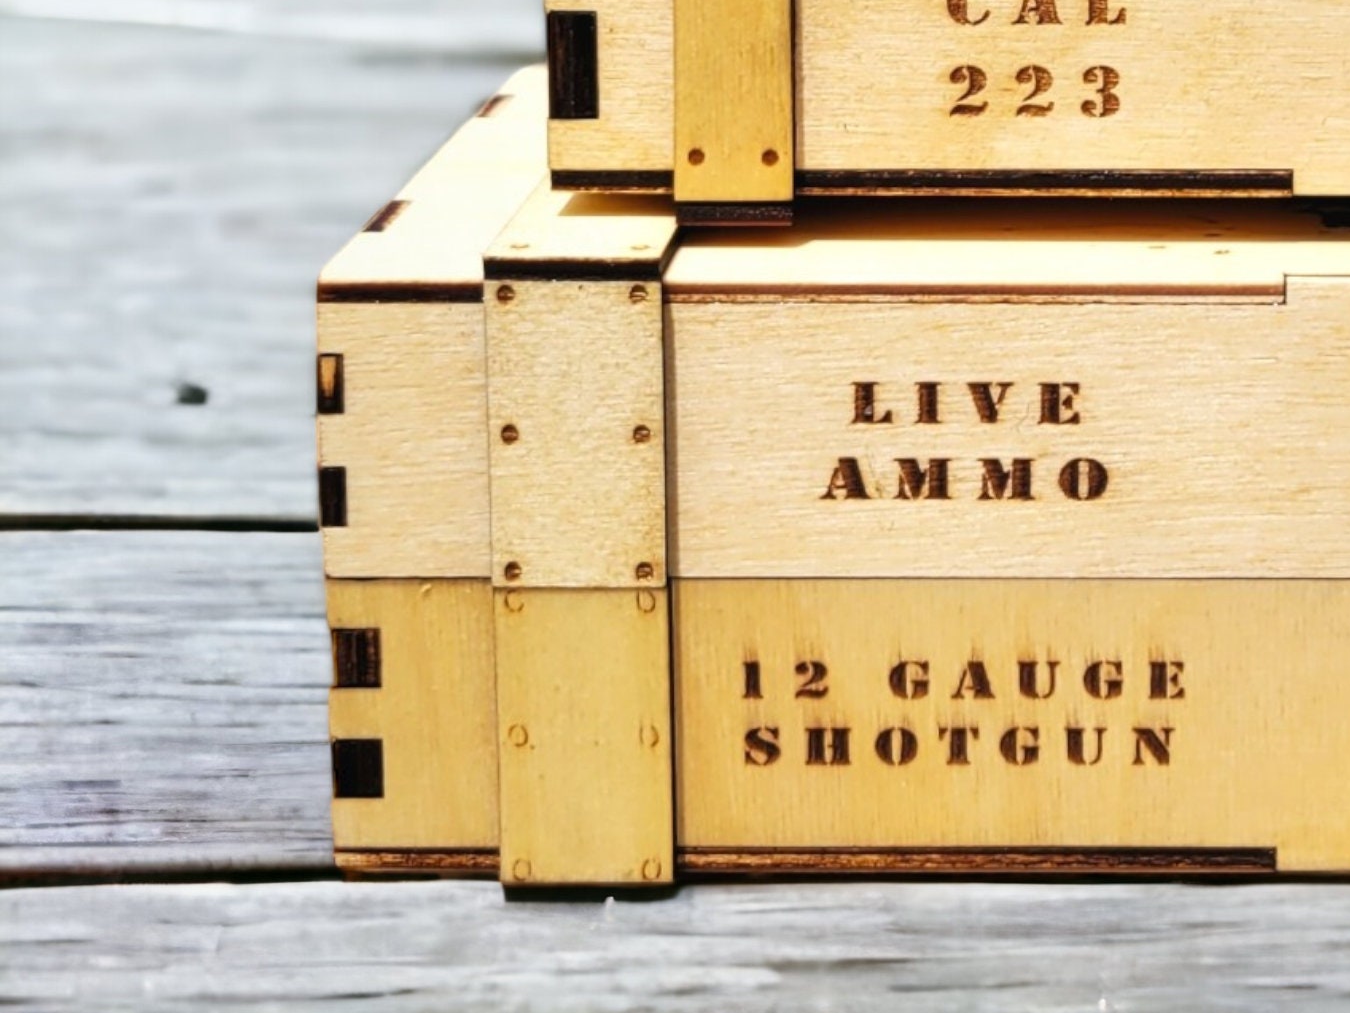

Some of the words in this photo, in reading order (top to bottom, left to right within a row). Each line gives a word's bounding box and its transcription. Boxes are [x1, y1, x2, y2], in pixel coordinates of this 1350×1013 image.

[949, 64, 1122, 118] 223
[851, 381, 1082, 424] LIVE
[821, 457, 1110, 501] AMMO
[742, 660, 829, 699] 12
[889, 660, 1186, 700] GAUGE
[744, 726, 1176, 766] SHOTGUN
